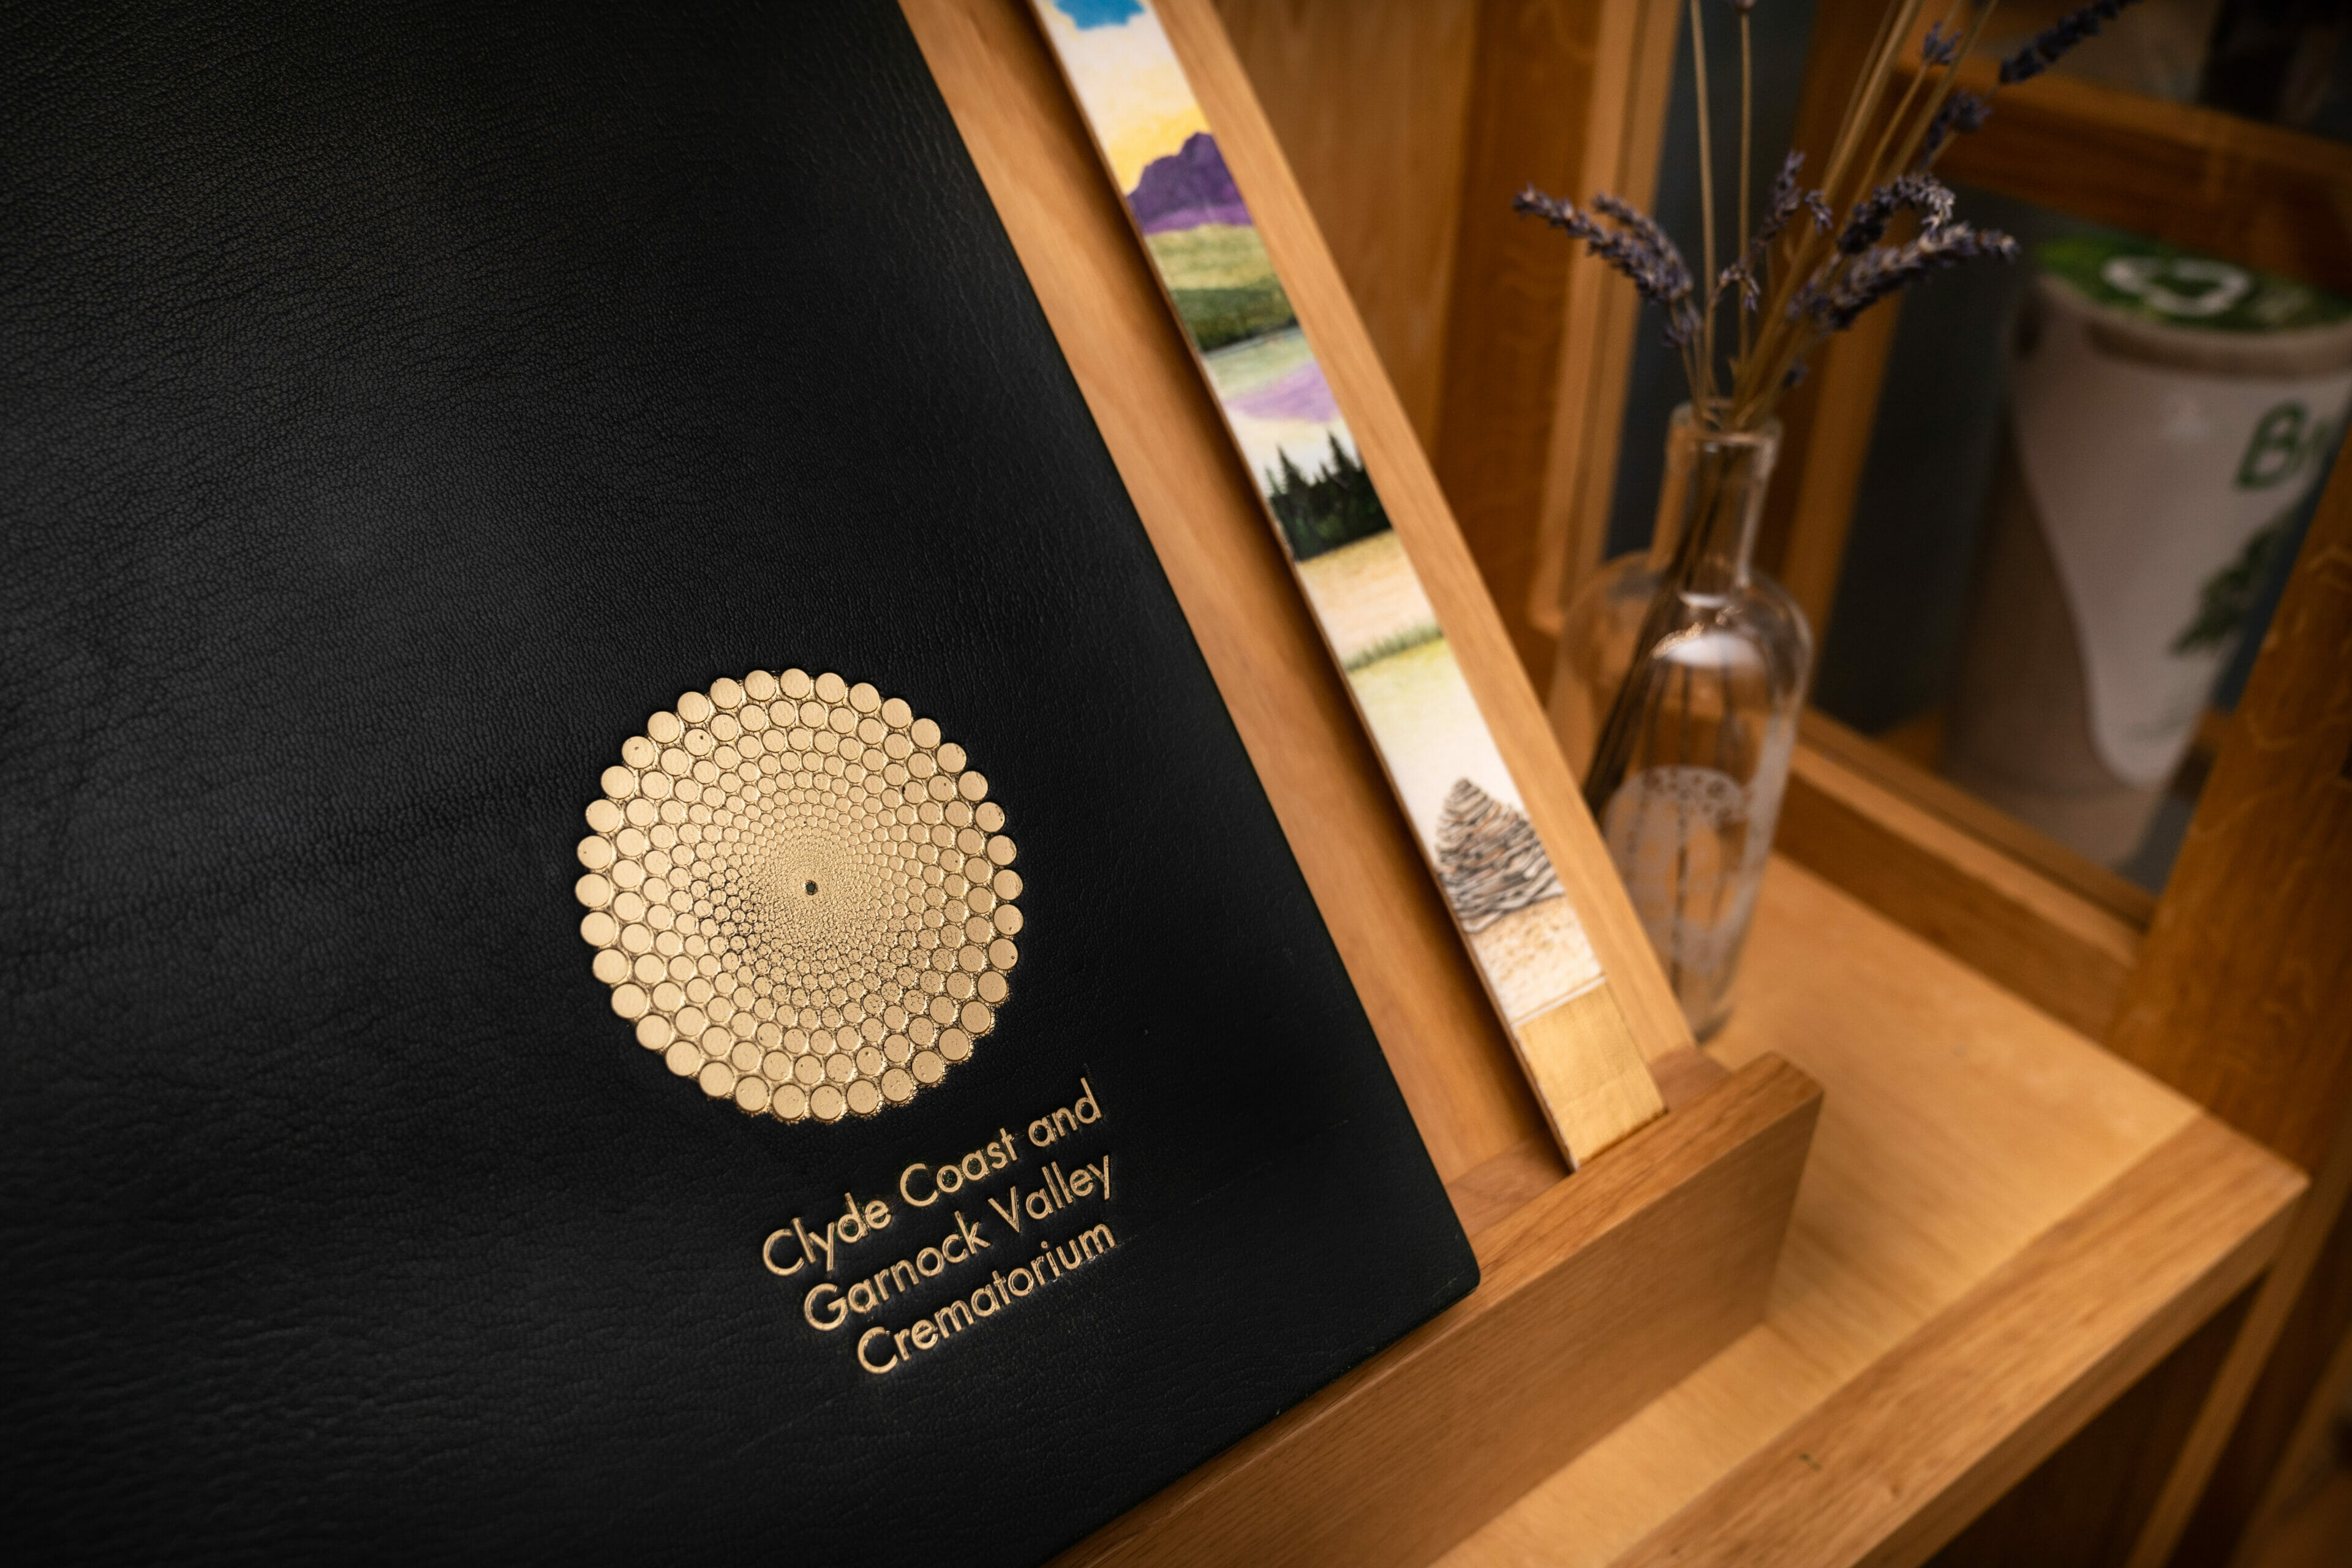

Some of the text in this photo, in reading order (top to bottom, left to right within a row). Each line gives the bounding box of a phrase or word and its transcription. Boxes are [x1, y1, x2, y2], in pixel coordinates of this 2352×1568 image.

[763, 1077, 1102, 1276] Clyde Coast and
[804, 1155, 1110, 1331] Garnock Valley
[858, 1223, 1116, 1374] Crematorium
